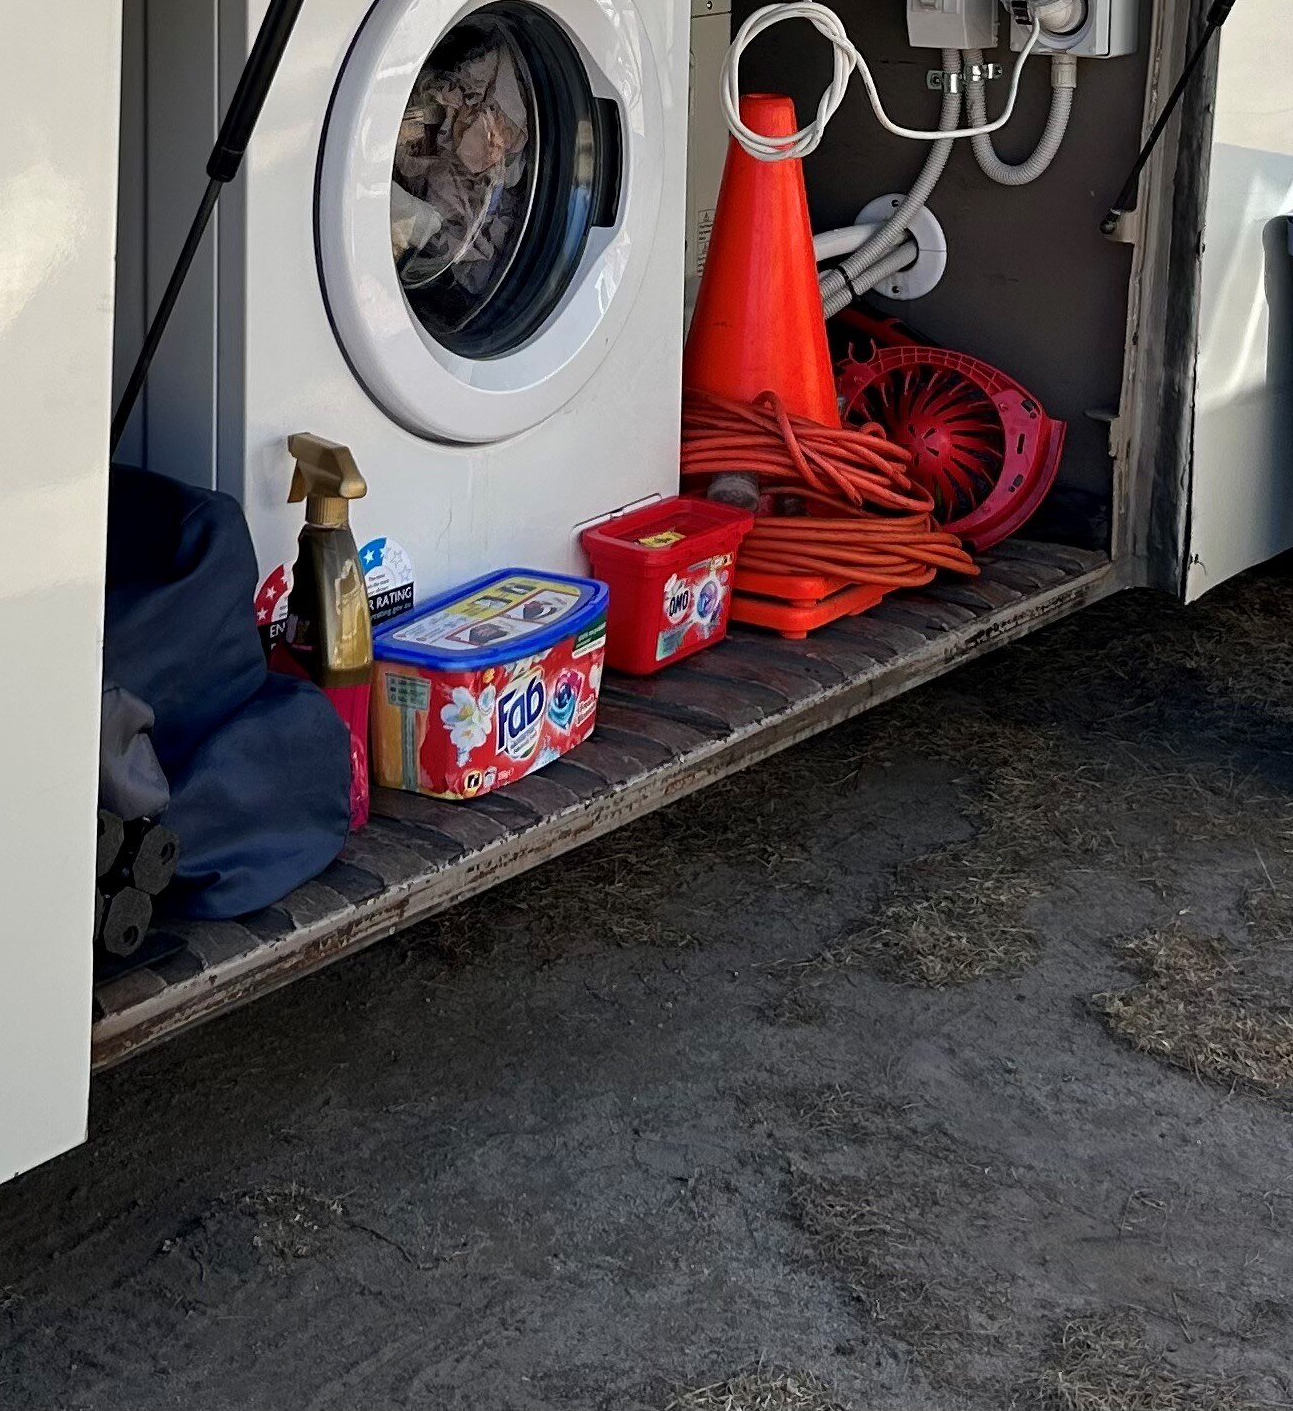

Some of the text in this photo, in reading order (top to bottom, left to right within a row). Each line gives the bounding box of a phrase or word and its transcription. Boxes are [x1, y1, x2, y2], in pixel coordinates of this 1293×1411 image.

[376, 586, 412, 609] RATING
[669, 589, 689, 618] OMO
[498, 675, 545, 751] Fab
